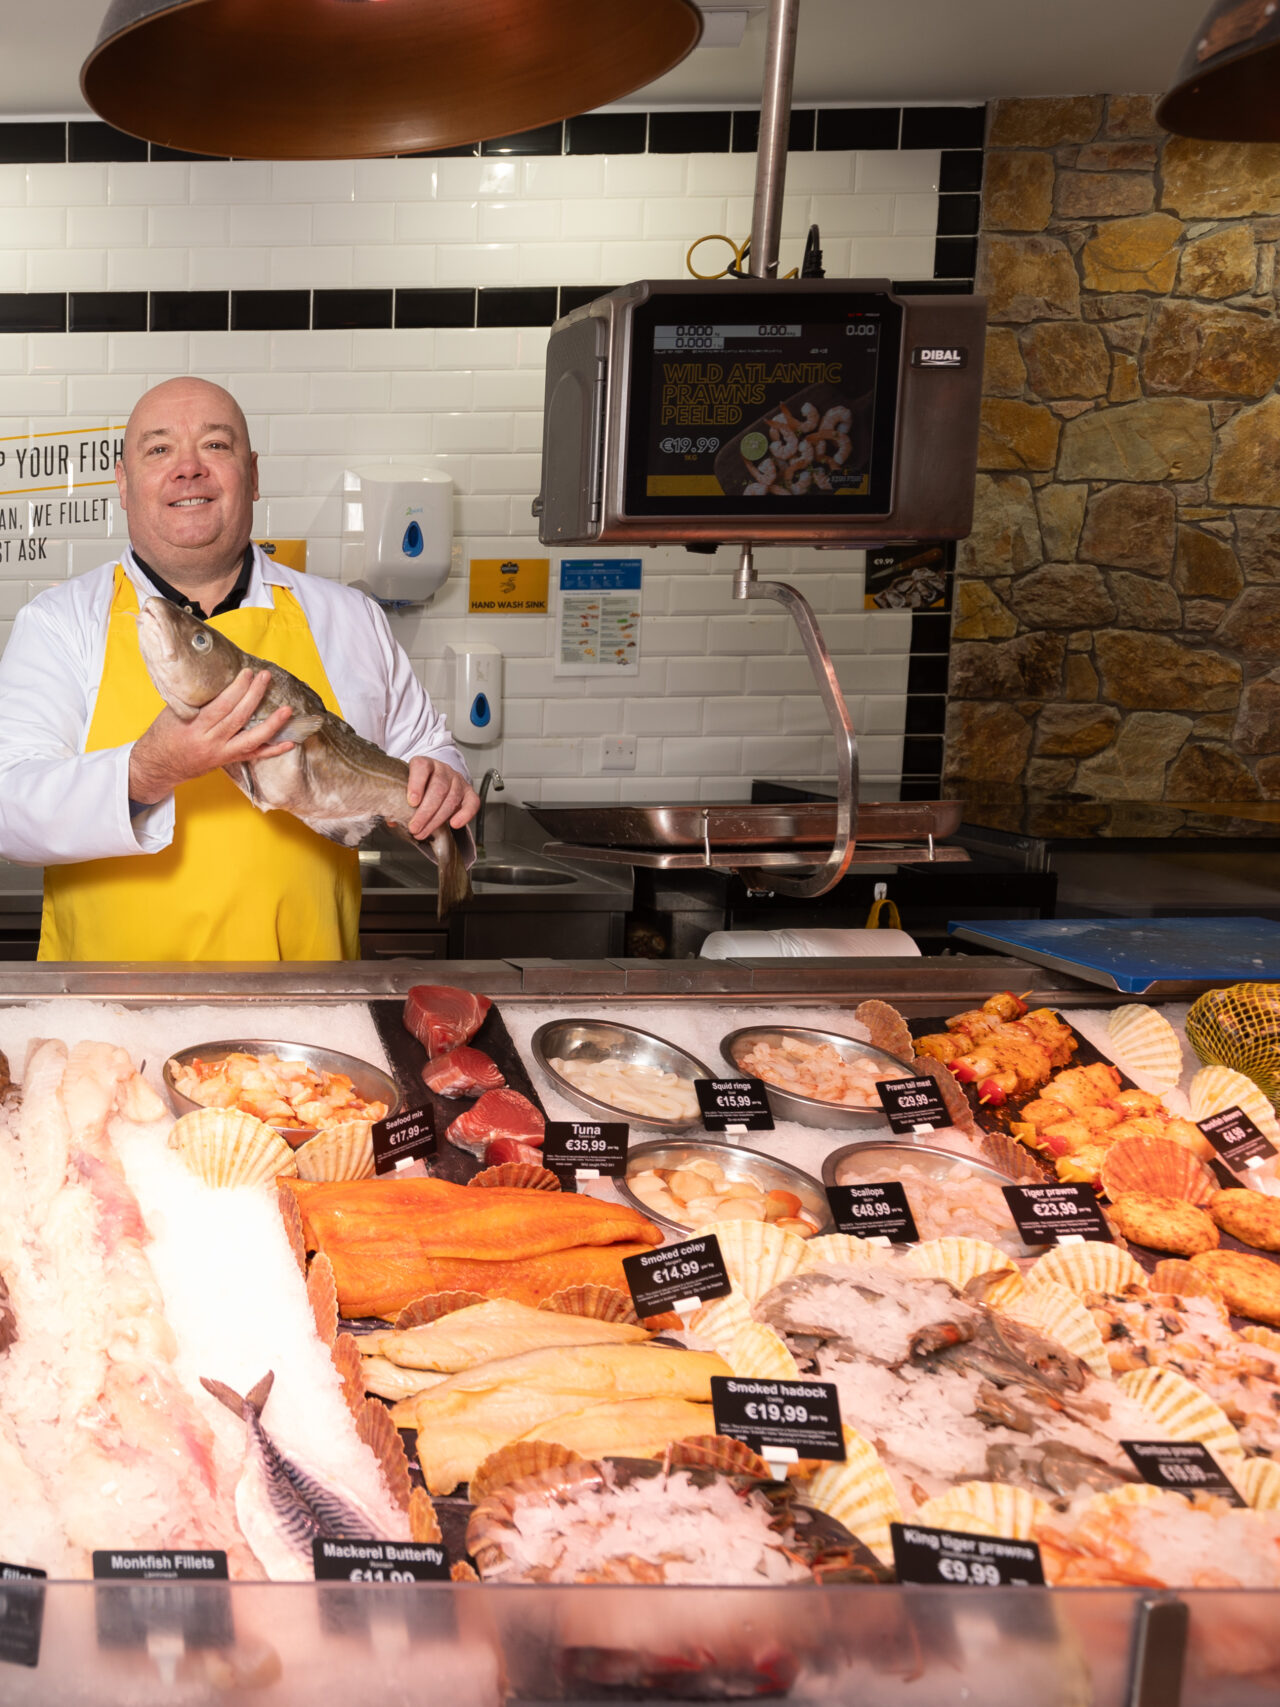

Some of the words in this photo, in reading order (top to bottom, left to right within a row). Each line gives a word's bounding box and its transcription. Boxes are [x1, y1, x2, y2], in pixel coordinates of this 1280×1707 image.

[921, 350, 961, 360] DIBAL
[663, 363, 724, 384] WILD
[728, 363, 842, 384] ATLANTIC
[662, 384, 766, 404] PRAWNS
[661, 405, 742, 425] PEELED
[659, 437, 720, 454] €19.99
[16, 444, 69, 478] YOUR
[80, 438, 124, 473] FISH
[31, 503, 52, 528] WE
[18, 537, 48, 562] ASK
[471, 600, 496, 609] HAND
[498, 600, 524, 609] WASH
[525, 600, 546, 608] SINK
[712, 1082, 732, 1091] Squid
[734, 1082, 752, 1091] rings
[885, 1084, 906, 1092] Prawn
[906, 1081, 916, 1089] tail
[916, 1080, 932, 1088] meat
[716, 1096, 751, 1108] €15,99
[898, 1094, 928, 1108] €29,99
[386, 1114, 411, 1130] Seafood
[412, 1110, 424, 1120] mix
[389, 1125, 420, 1145] €17,99
[572, 1124, 601, 1135] Tuna
[565, 1140, 606, 1152] €35,99
[850, 1188, 884, 1198] Scallops
[1020, 1188, 1044, 1199] Tiger
[1046, 1188, 1078, 1197] prawns
[852, 1202, 891, 1218] €48,99
[1032, 1202, 1078, 1216] €23,99
[640, 1248, 680, 1266] Smoked
[680, 1242, 706, 1256] coley
[652, 1260, 700, 1284] €14,99
[726, 1380, 778, 1395] Smoked
[780, 1384, 828, 1398] hadock
[744, 1402, 808, 1423] €19,99
[902, 1528, 940, 1550] King
[940, 1534, 977, 1552] tiger
[978, 1541, 1035, 1560] prawns
[110, 1555, 172, 1570] Monkfish
[174, 1555, 216, 1570] Fillets
[323, 1542, 383, 1560] Mackerel
[385, 1546, 444, 1566] Butterfly
[2, 1569, 42, 1580] fillet
[938, 1558, 1000, 1586] €9,99
